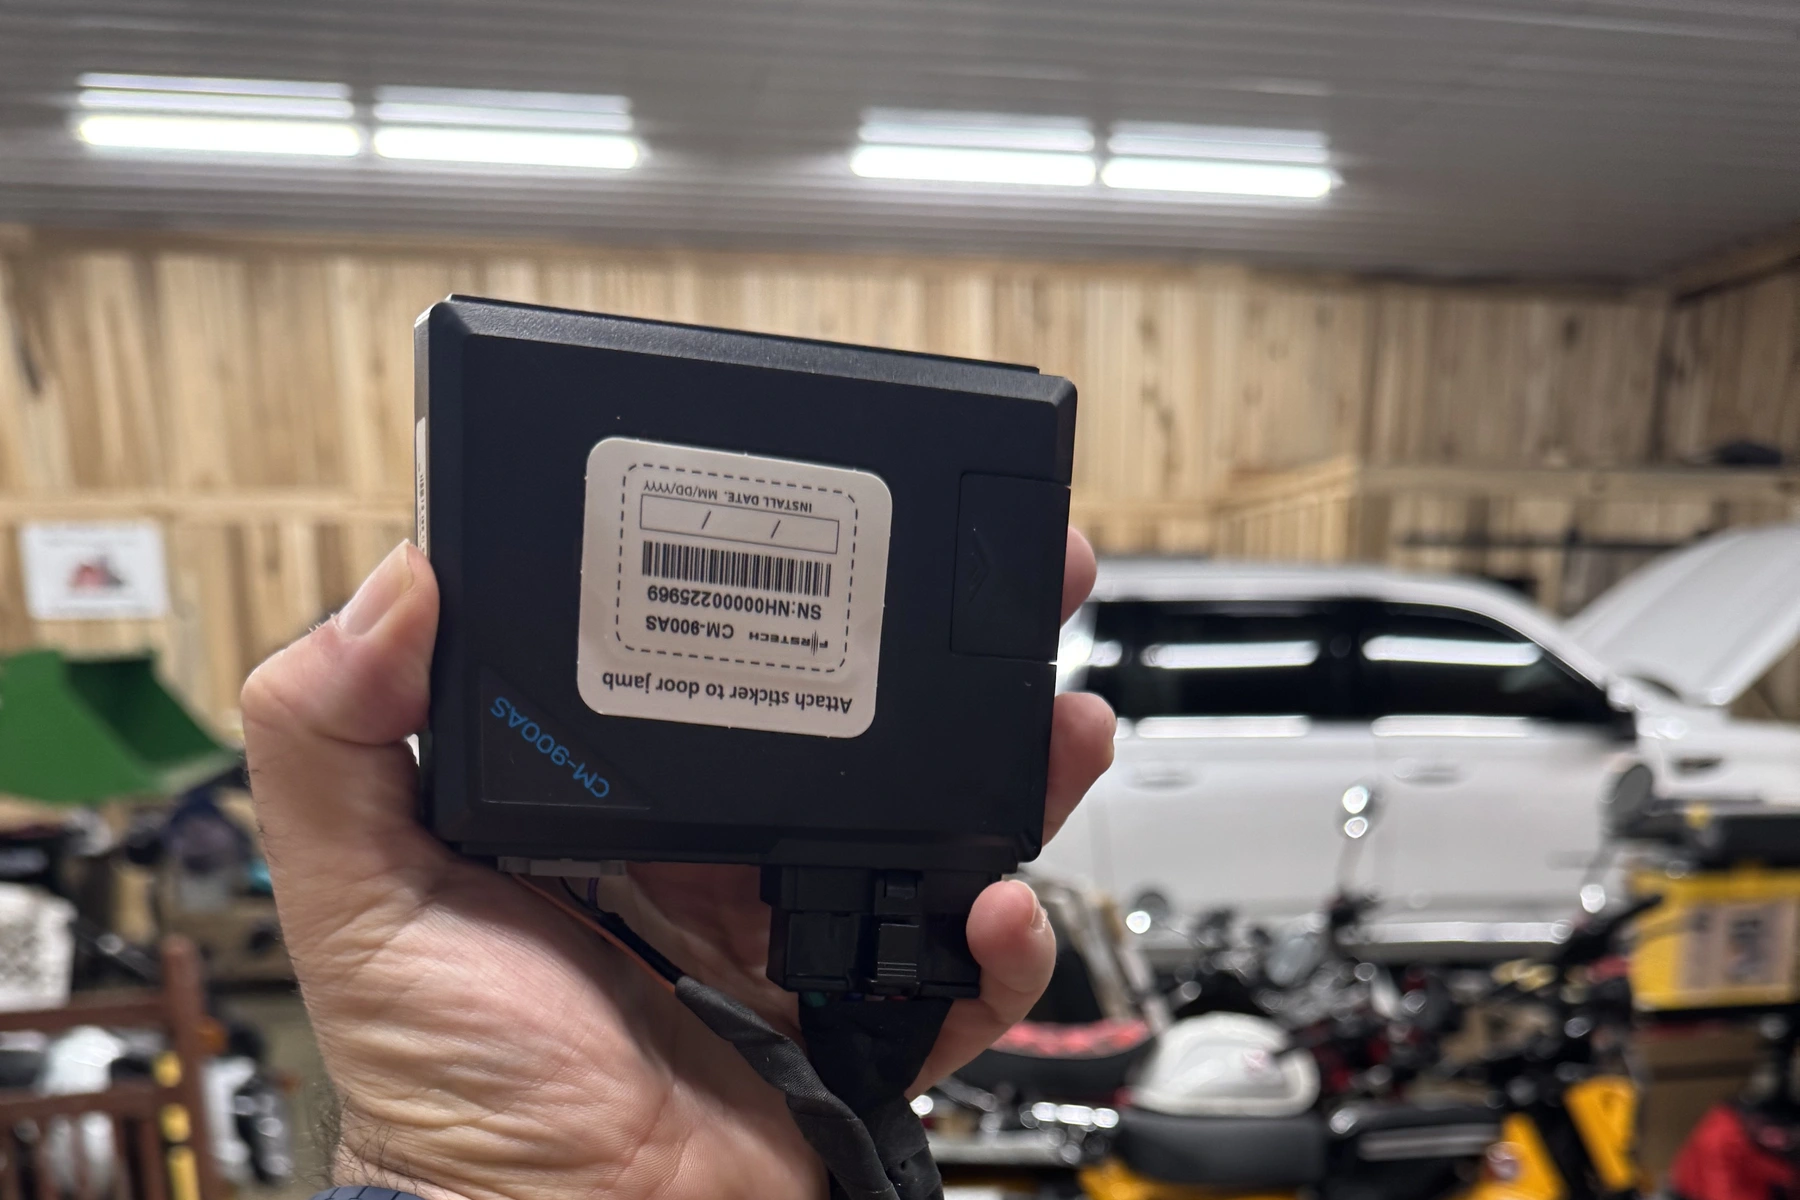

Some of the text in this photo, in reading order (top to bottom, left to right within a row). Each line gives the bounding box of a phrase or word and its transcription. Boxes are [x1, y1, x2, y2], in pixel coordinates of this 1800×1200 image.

[644, 480, 718, 500] MM/DD/YYYY
[763, 496, 812, 513] INSTALL
[647, 585, 821, 620] SN:NH00000225969
[646, 615, 734, 639] CM-900AS
[603, 672, 852, 714] Attach sticker to door jamb
[490, 697, 610, 798] CM-900AS
